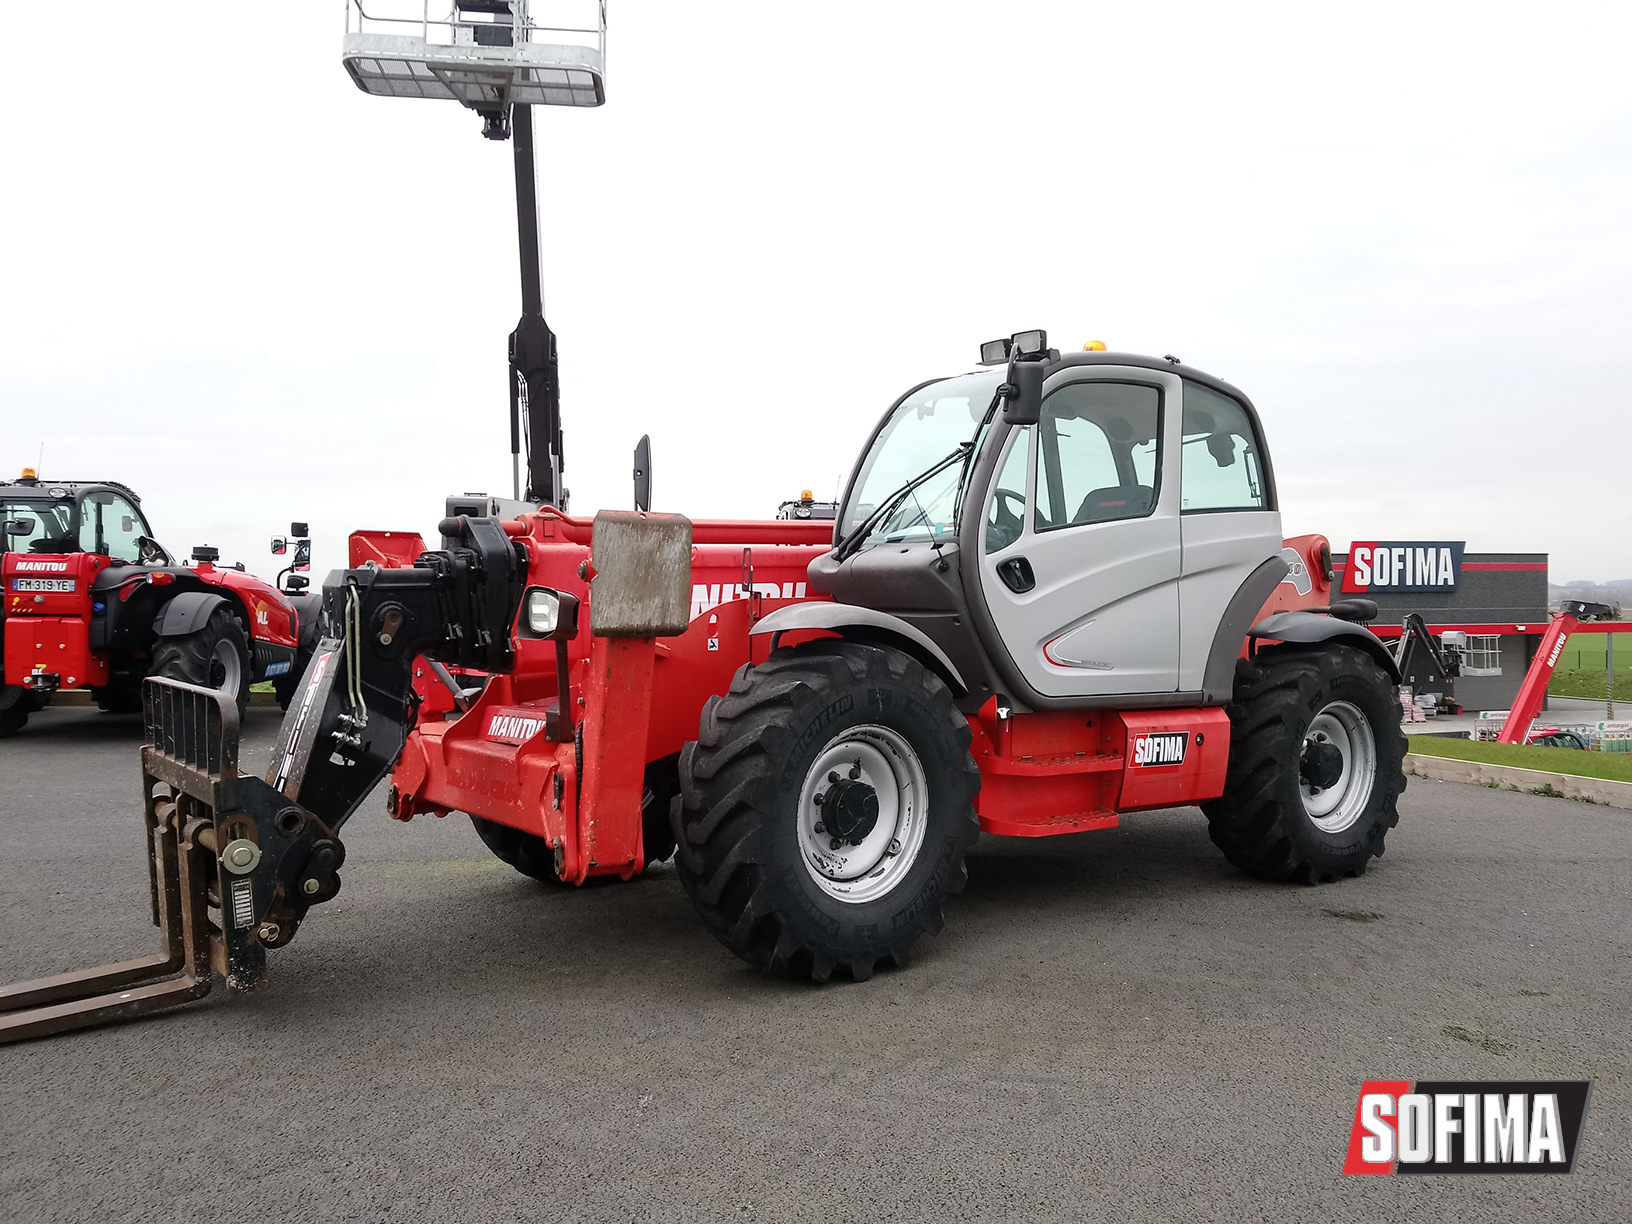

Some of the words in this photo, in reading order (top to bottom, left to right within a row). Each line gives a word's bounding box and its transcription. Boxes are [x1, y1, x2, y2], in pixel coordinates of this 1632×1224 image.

[16, 562, 68, 571] MANITOU
[1354, 547, 1455, 586] SOFIMA
[18, 580, 69, 591] FM-319-YE
[1547, 632, 1567, 668] MANITOU
[1135, 736, 1183, 764] SOFIMA
